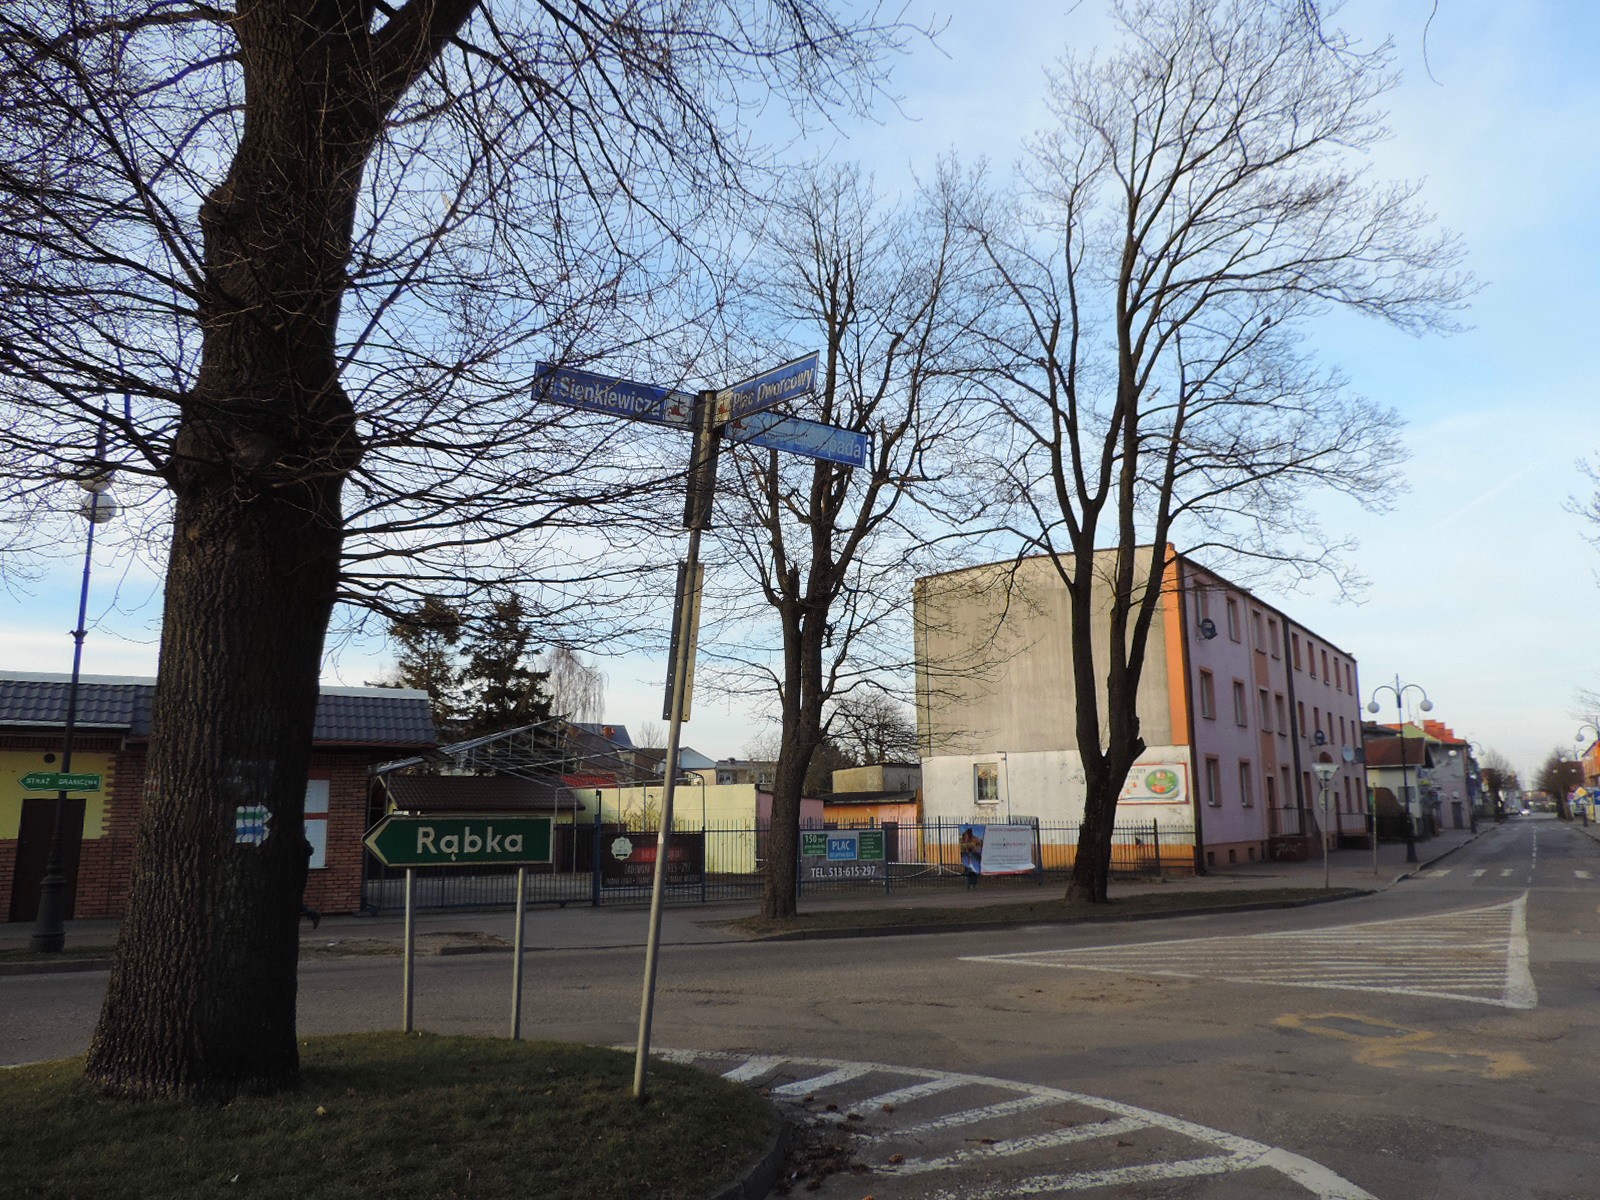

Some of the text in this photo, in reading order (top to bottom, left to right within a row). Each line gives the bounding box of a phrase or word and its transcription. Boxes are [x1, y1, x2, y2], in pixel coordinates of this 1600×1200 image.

[733, 367, 814, 408] Plac Dworcowy
[416, 826, 523, 861] Rąbka
[804, 834, 817, 843] 150
[832, 840, 850, 851] PLAC
[811, 866, 876, 878] TEL. 513-615-297
